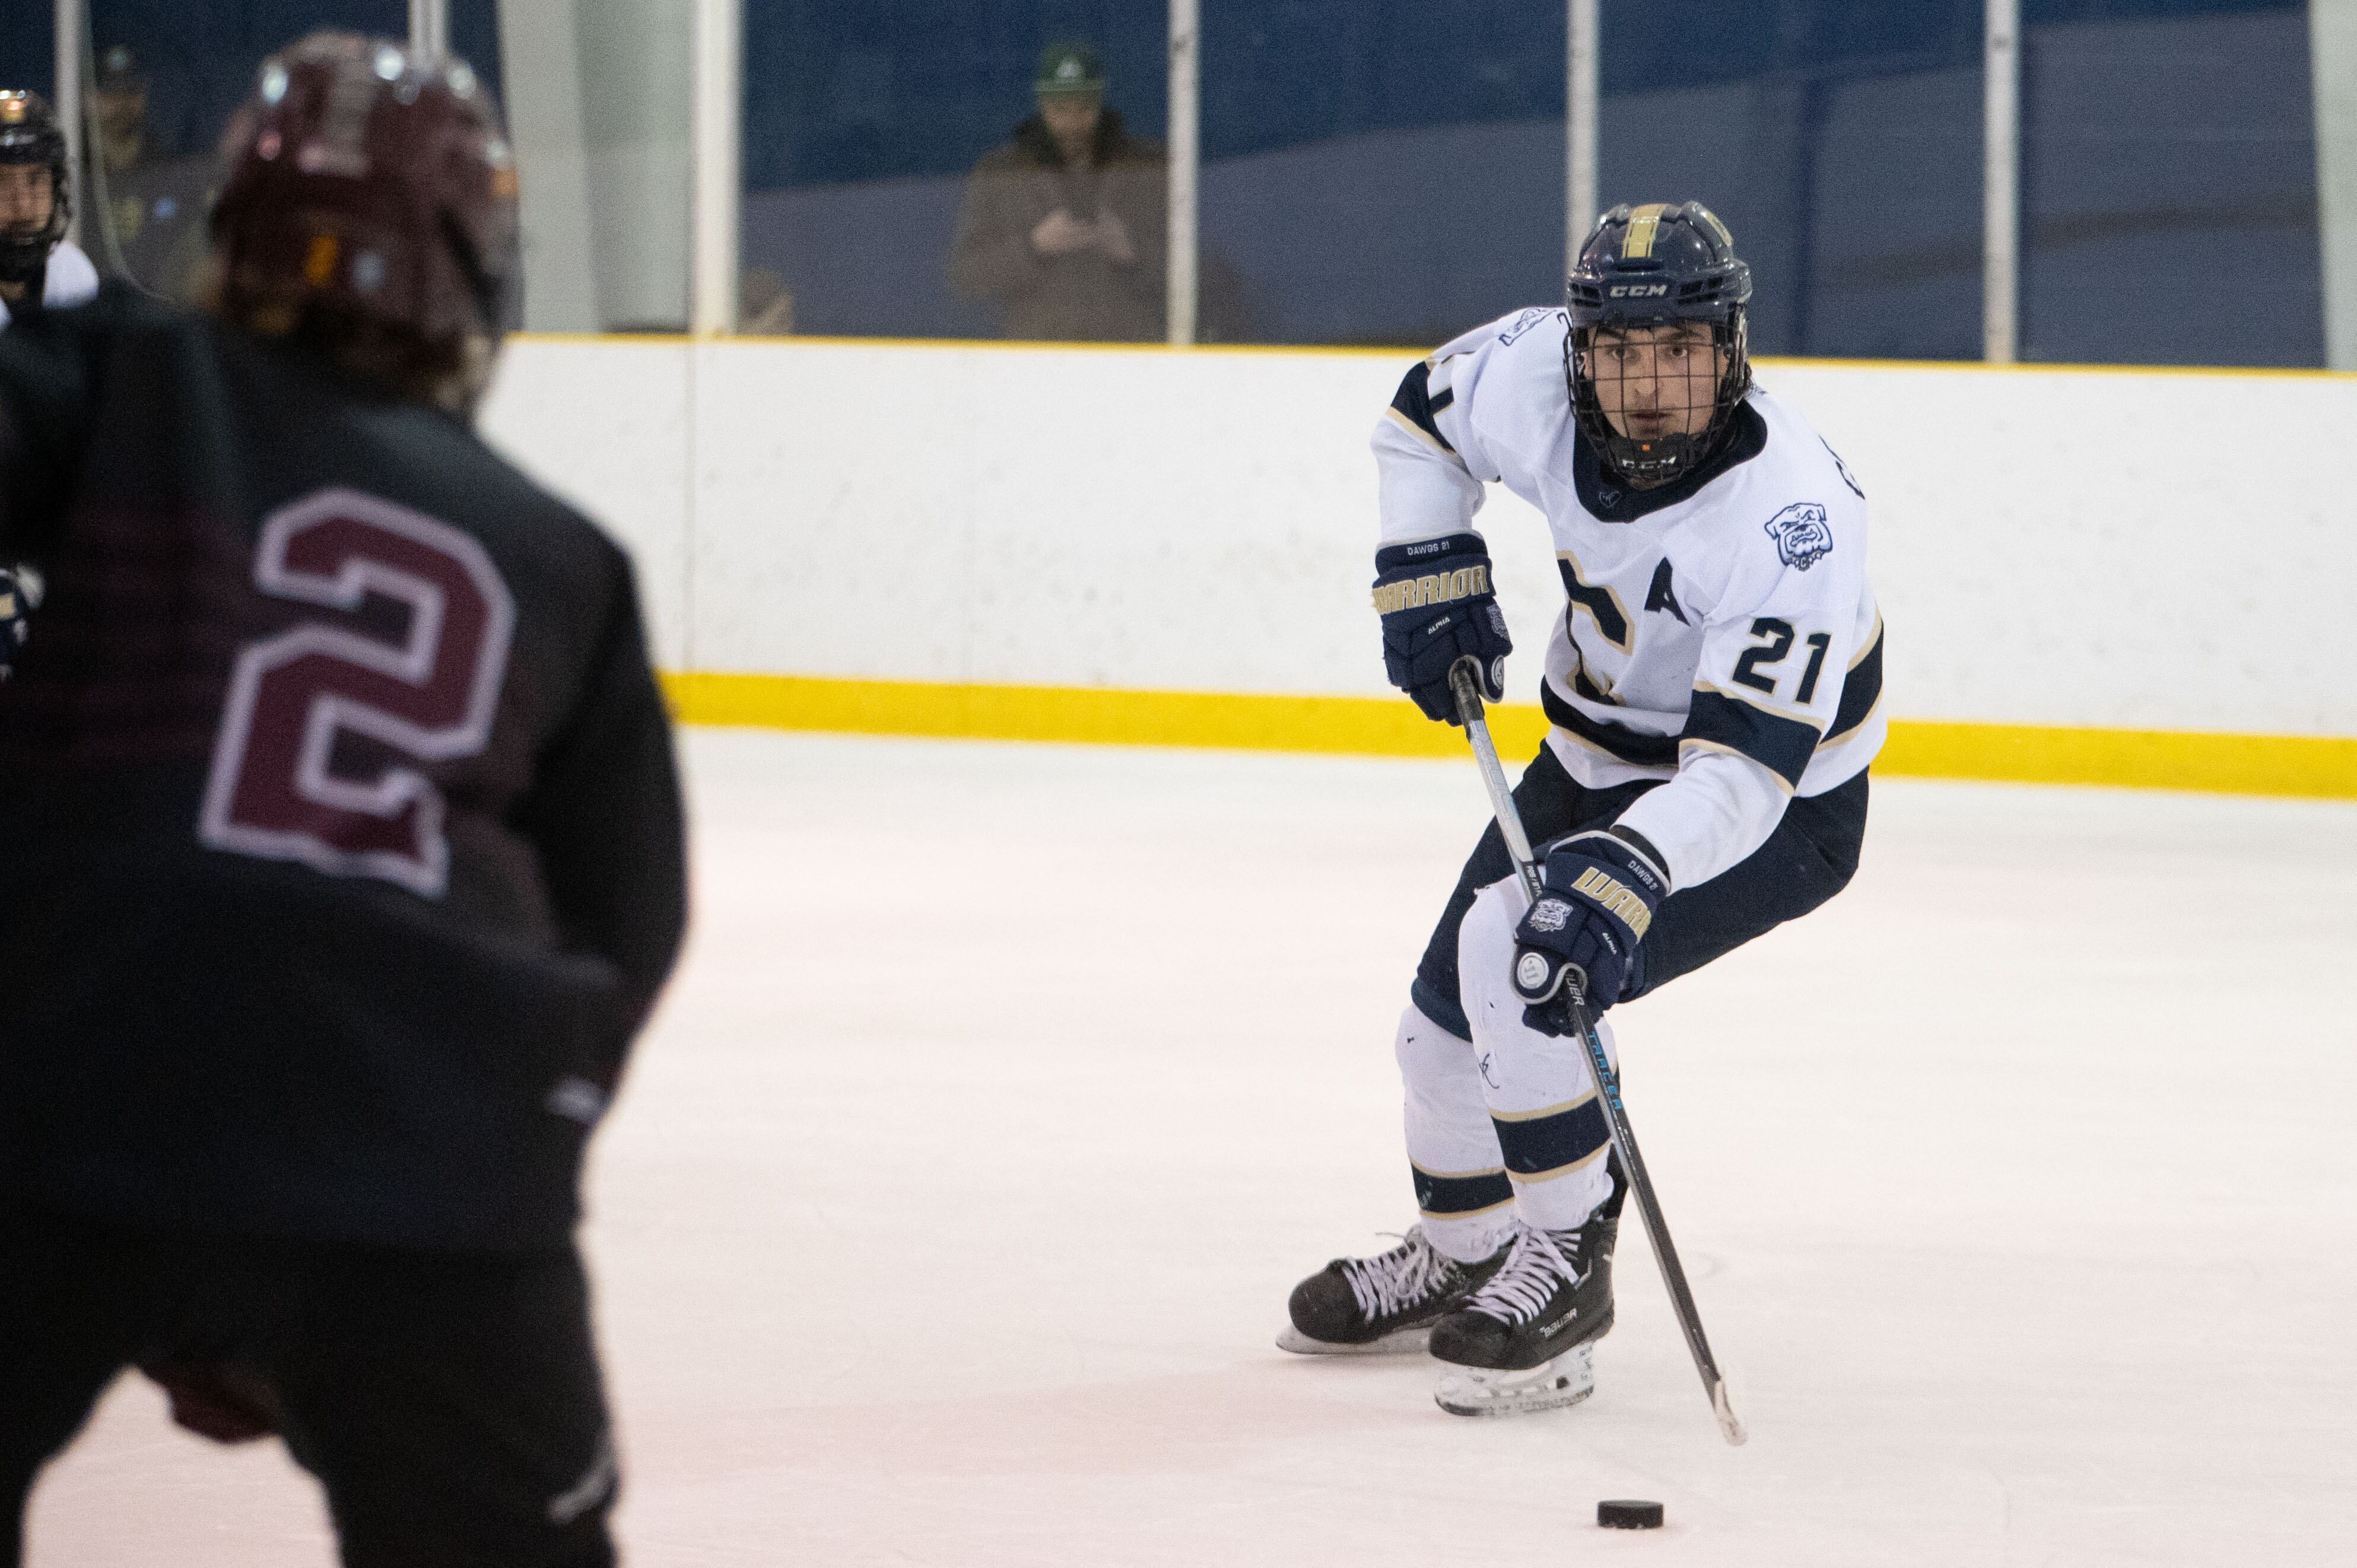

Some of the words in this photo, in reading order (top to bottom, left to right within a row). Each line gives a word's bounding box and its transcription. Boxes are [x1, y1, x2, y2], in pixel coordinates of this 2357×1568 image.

[1610, 285, 1667, 297] CCM
[1407, 543, 1438, 556] DAWGS
[1441, 541, 1450, 551] 21
[1644, 557, 1690, 626] A
[1428, 616, 1451, 635] ALPHA
[1732, 617, 1832, 705] 21
[199, 486, 517, 898] 2
[1628, 860, 1654, 885] DAWGS
